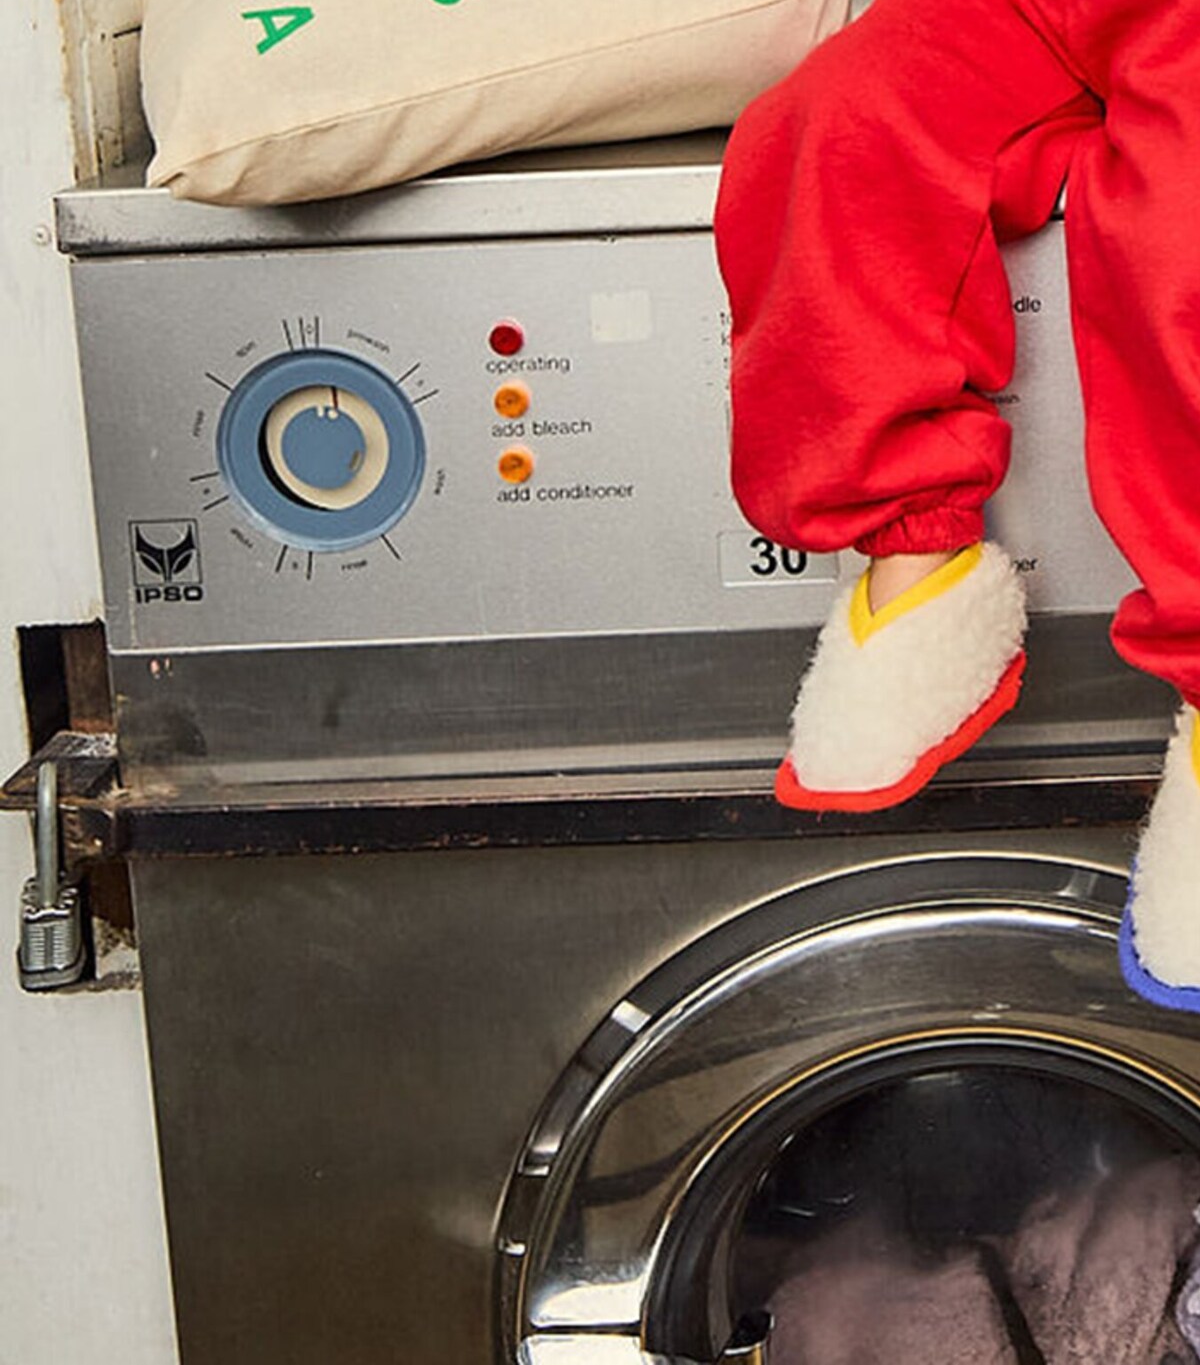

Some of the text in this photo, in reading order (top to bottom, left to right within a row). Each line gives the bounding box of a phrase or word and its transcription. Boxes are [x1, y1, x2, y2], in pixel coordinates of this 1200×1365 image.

[485, 357, 571, 374] operating
[491, 419, 593, 437] add bleach
[497, 484, 634, 503] add conditioner
[750, 537, 807, 576] 30
[135, 586, 204, 604] IPSO
